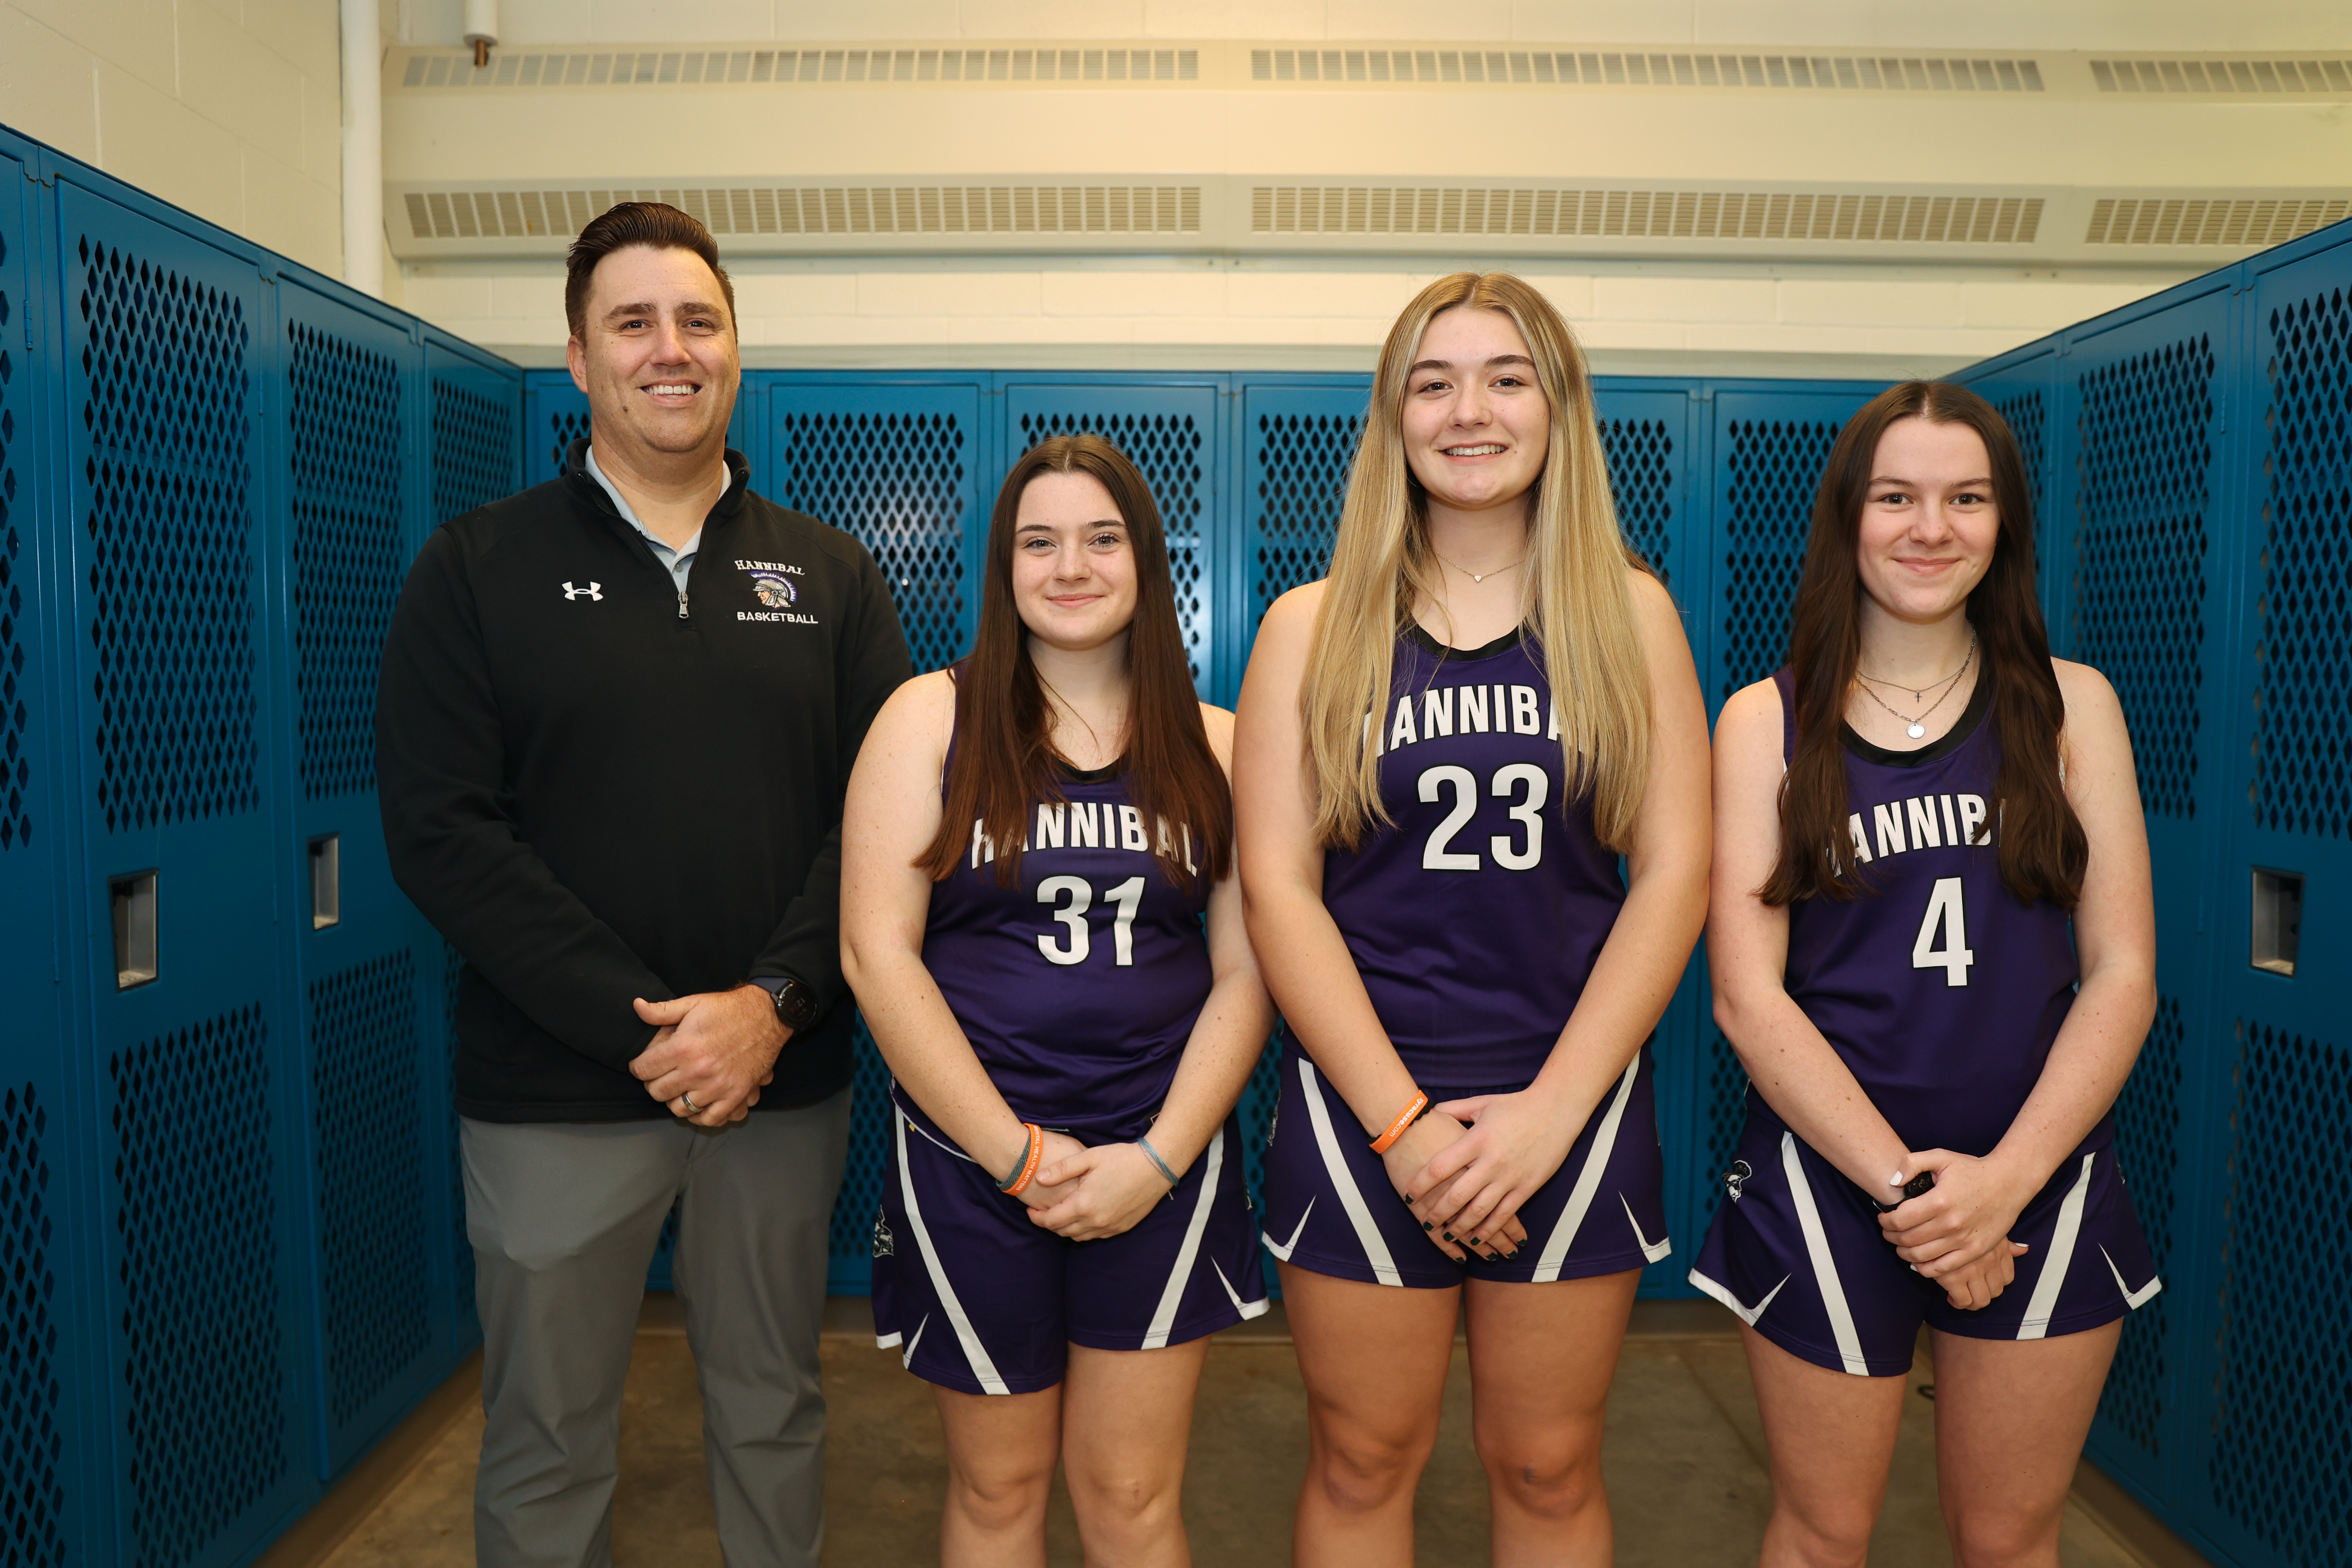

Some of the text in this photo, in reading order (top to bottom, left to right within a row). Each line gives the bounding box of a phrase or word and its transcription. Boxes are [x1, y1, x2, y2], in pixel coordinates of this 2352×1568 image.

[734, 559, 805, 576] HANNIBAL
[737, 611, 818, 624] BASKETBALL
[1363, 684, 1589, 758] ANNIB
[1417, 763, 1549, 870] 23
[1826, 794, 2007, 878] ANNIB
[1037, 875, 1145, 965] 31
[1912, 877, 1973, 986] 4
[1389, 1097, 1424, 1138] syracuse.com
[1016, 1169, 1033, 1191] MATTERS
[1029, 1146, 1040, 1169] HEALTH
